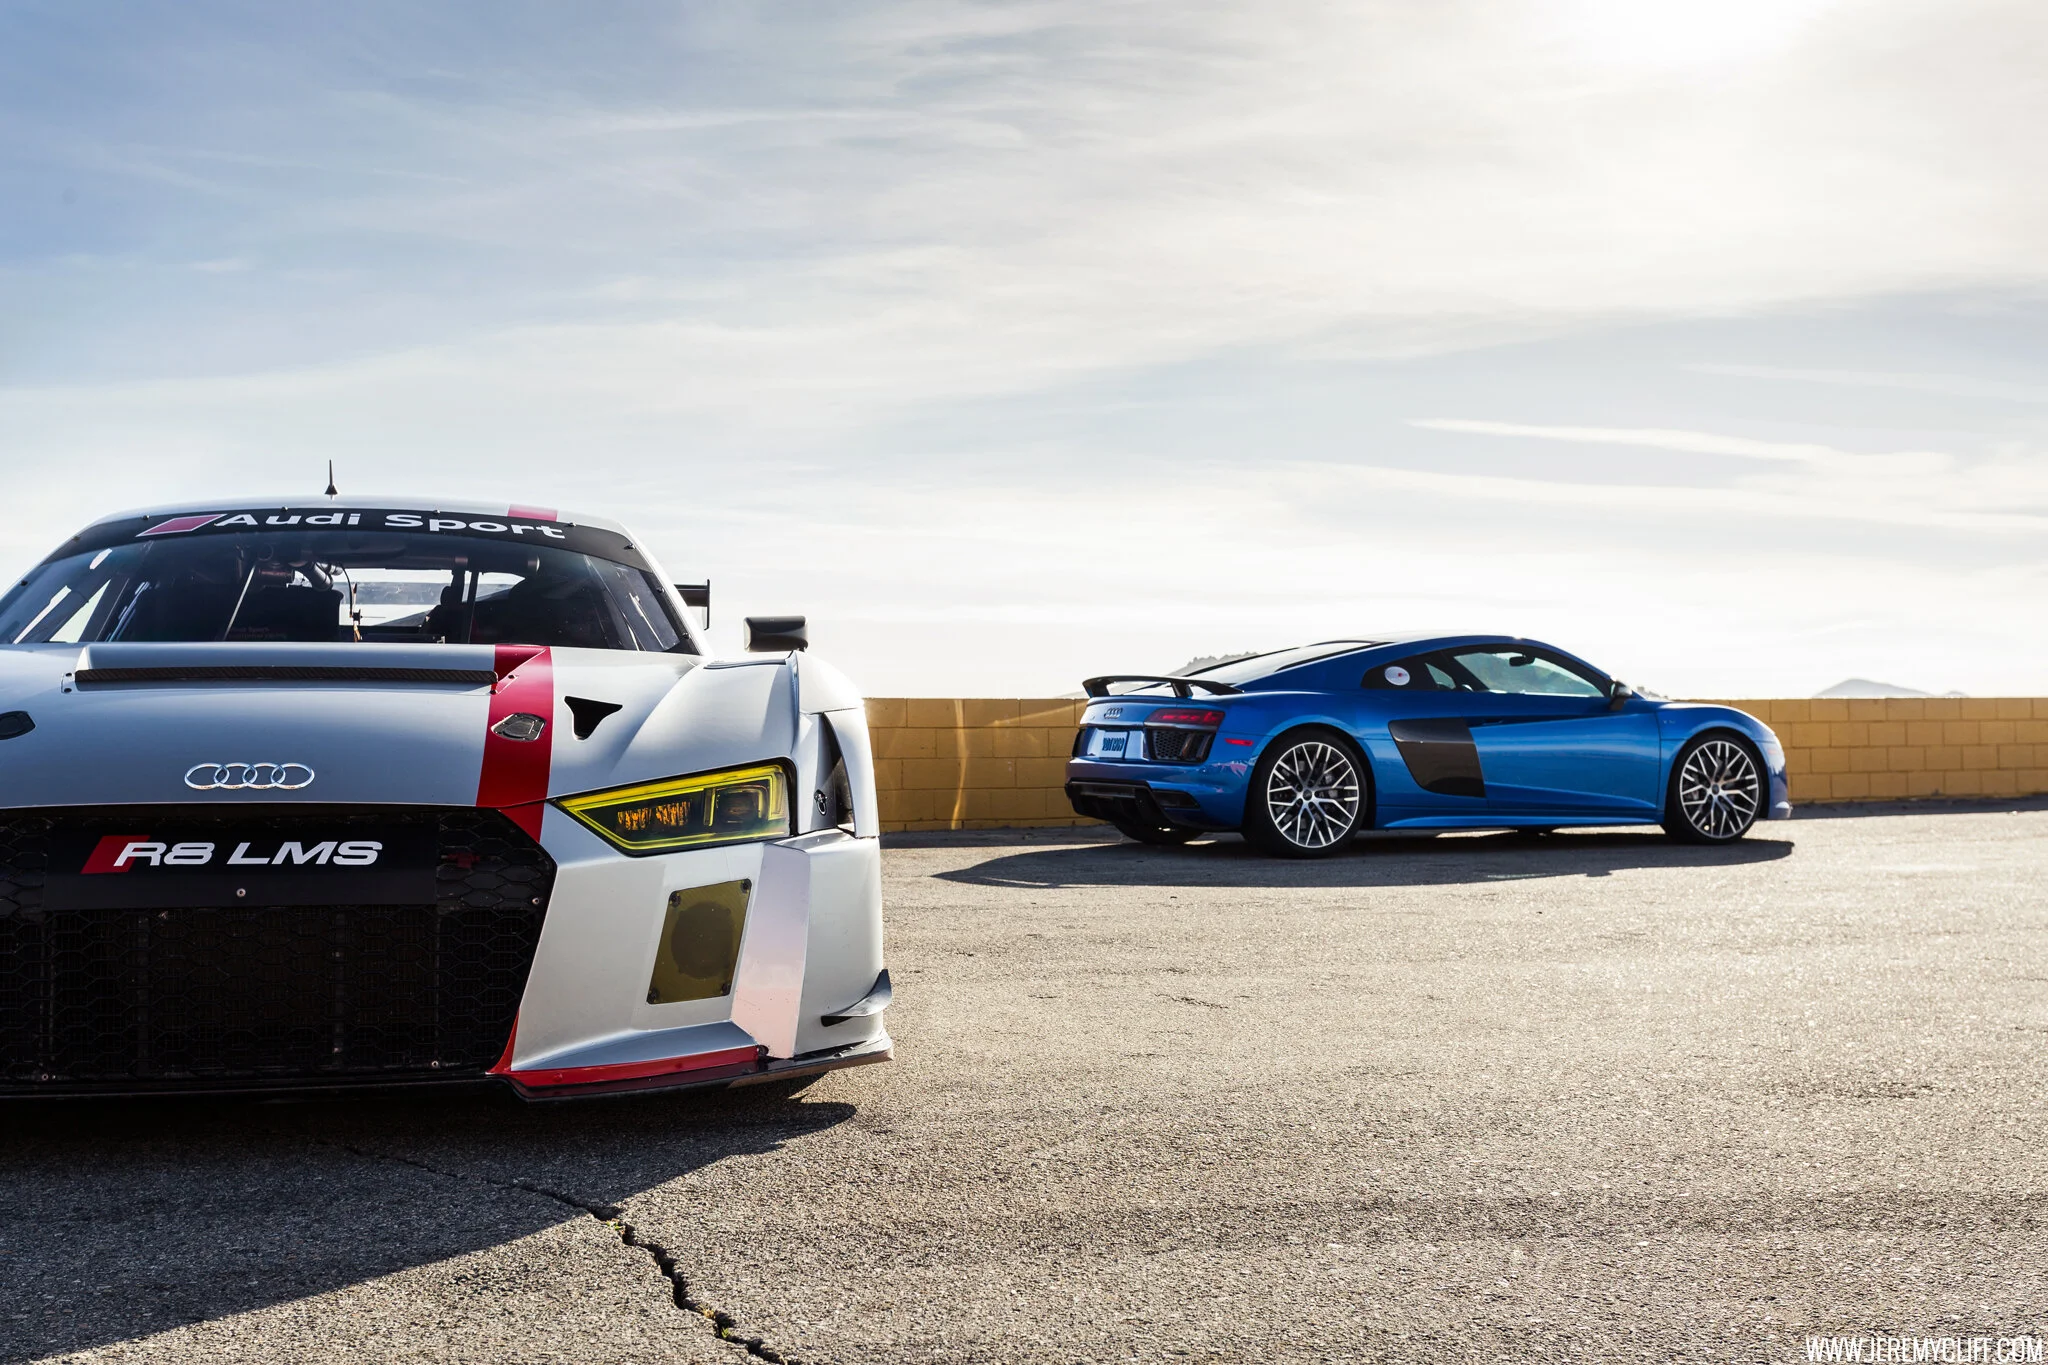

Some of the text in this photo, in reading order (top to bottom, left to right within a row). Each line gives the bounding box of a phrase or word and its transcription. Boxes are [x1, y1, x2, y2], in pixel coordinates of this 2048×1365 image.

[215, 512, 565, 539] Audi Sport
[113, 841, 383, 866] R8 LMS
